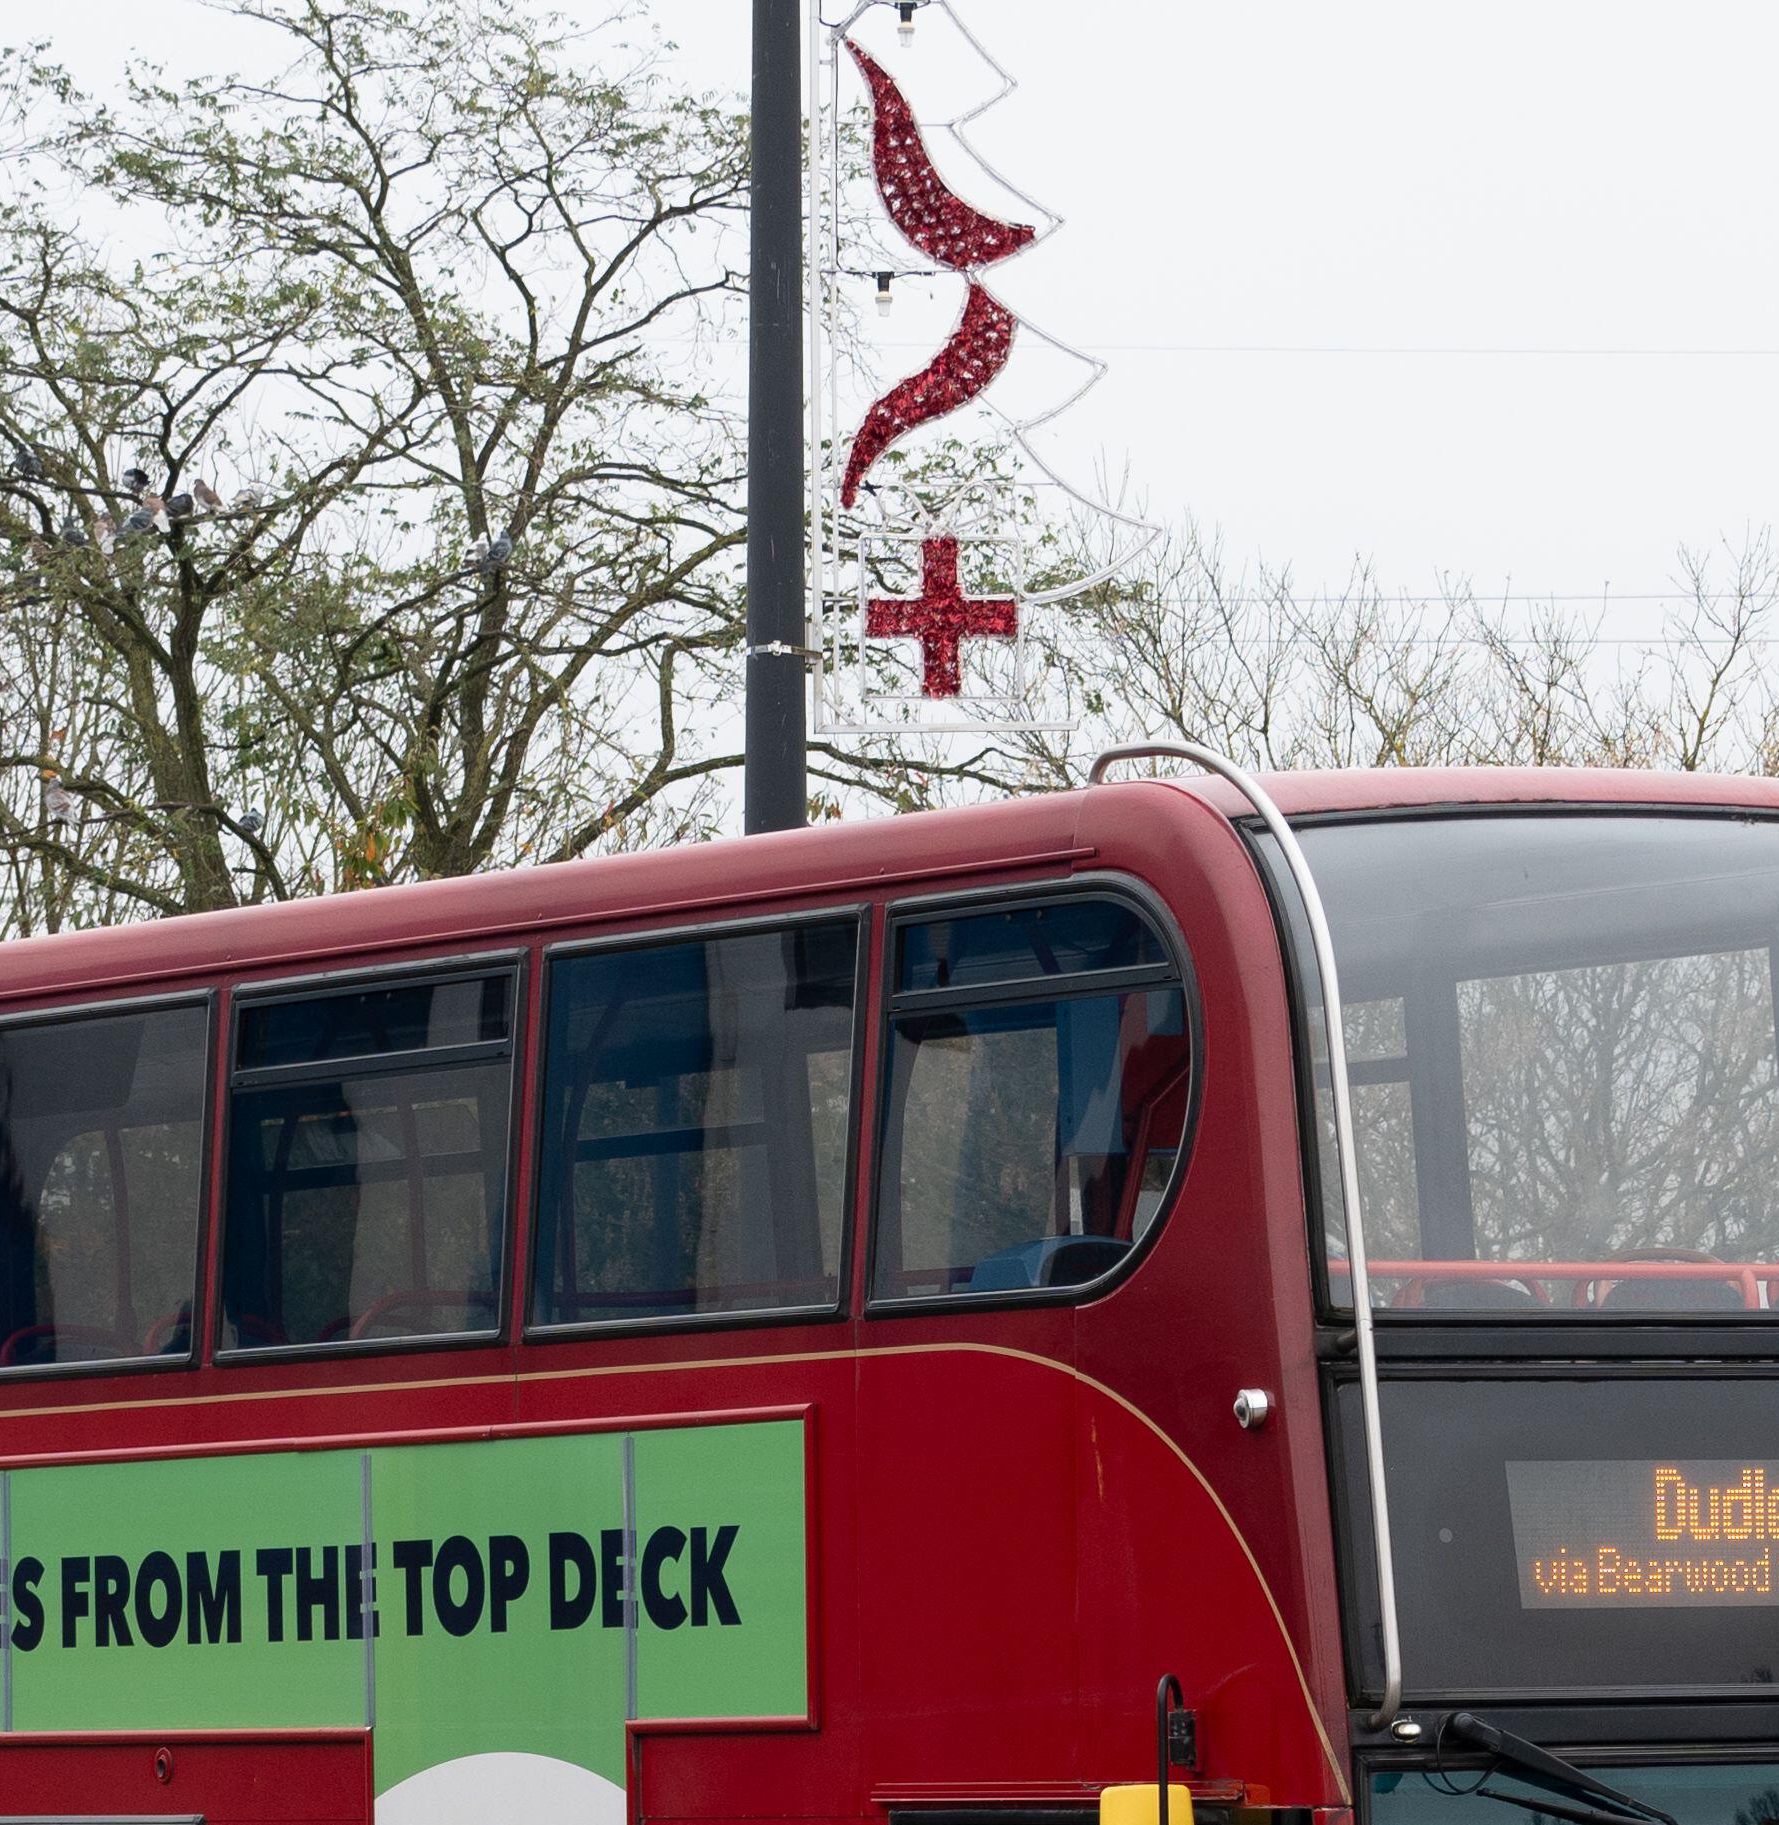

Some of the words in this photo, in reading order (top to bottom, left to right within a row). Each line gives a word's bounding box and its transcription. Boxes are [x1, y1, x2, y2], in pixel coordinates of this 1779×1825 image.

[61, 1549, 242, 1648] FROM
[256, 1542, 380, 1642] THE
[393, 1534, 530, 1637] TOP
[548, 1525, 743, 1631] DECK
[1535, 1547, 1588, 1594] via
[1598, 1546, 1771, 1594] Bearwood
